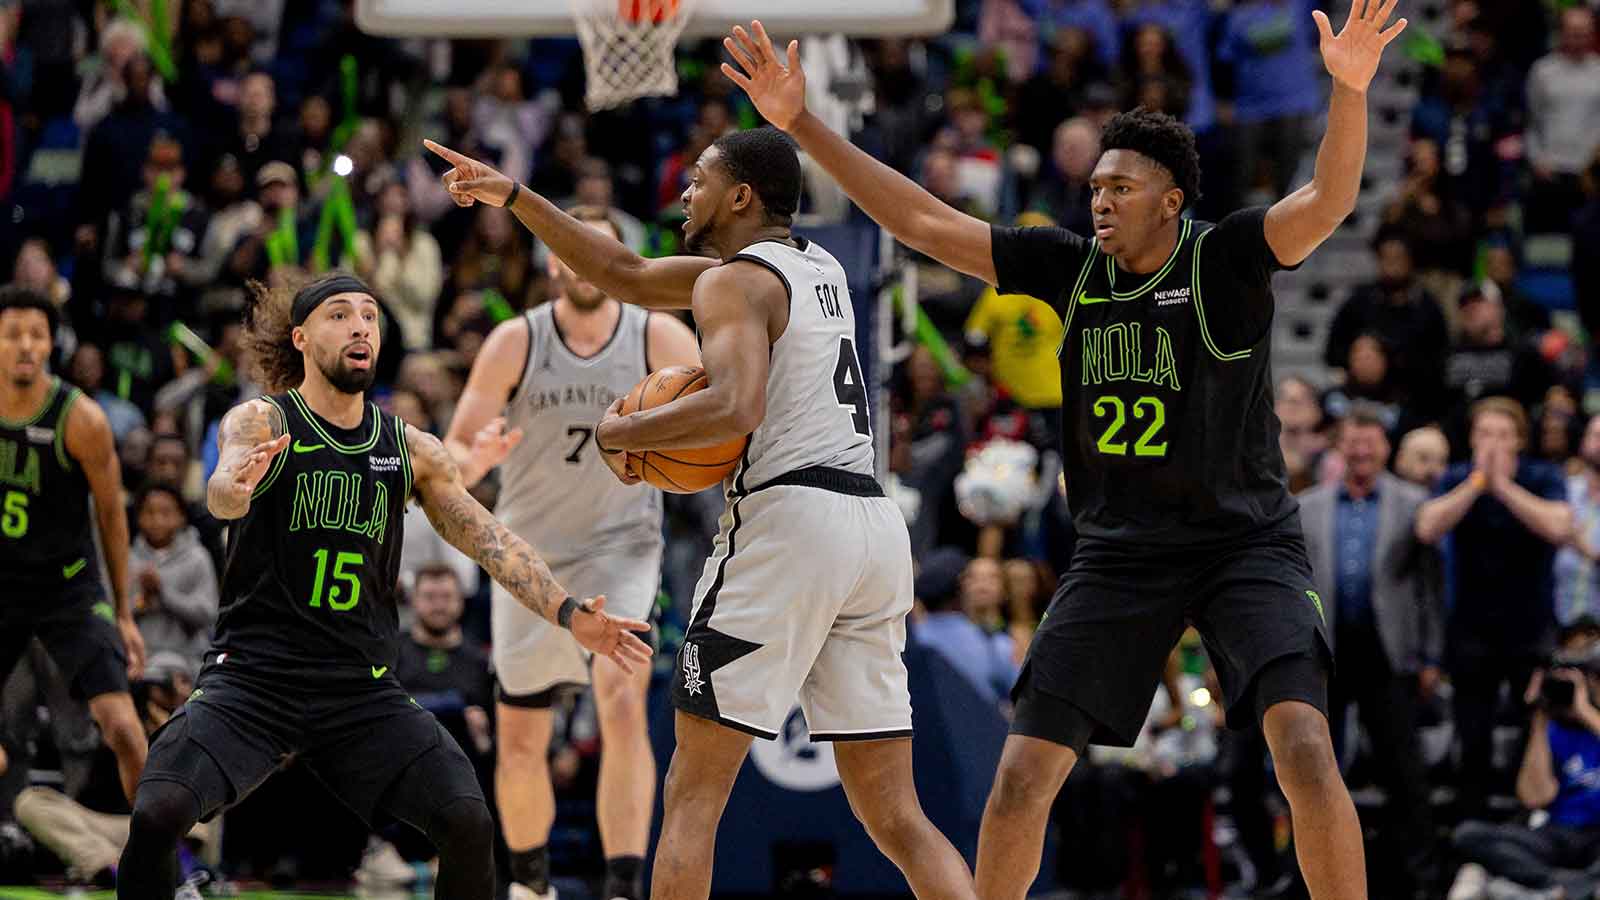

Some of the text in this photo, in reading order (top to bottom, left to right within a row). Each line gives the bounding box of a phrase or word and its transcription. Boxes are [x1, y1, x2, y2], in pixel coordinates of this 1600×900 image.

[815, 283, 845, 319] FOX
[1154, 287, 1191, 300] NEWAGE
[1157, 297, 1189, 306] PRODUCTS
[833, 335, 872, 437] 4
[1082, 322, 1182, 391] NOLA
[565, 424, 594, 464] 7
[1093, 395, 1168, 456] 22
[289, 470, 388, 544] NOLA
[309, 548, 364, 611] 15
